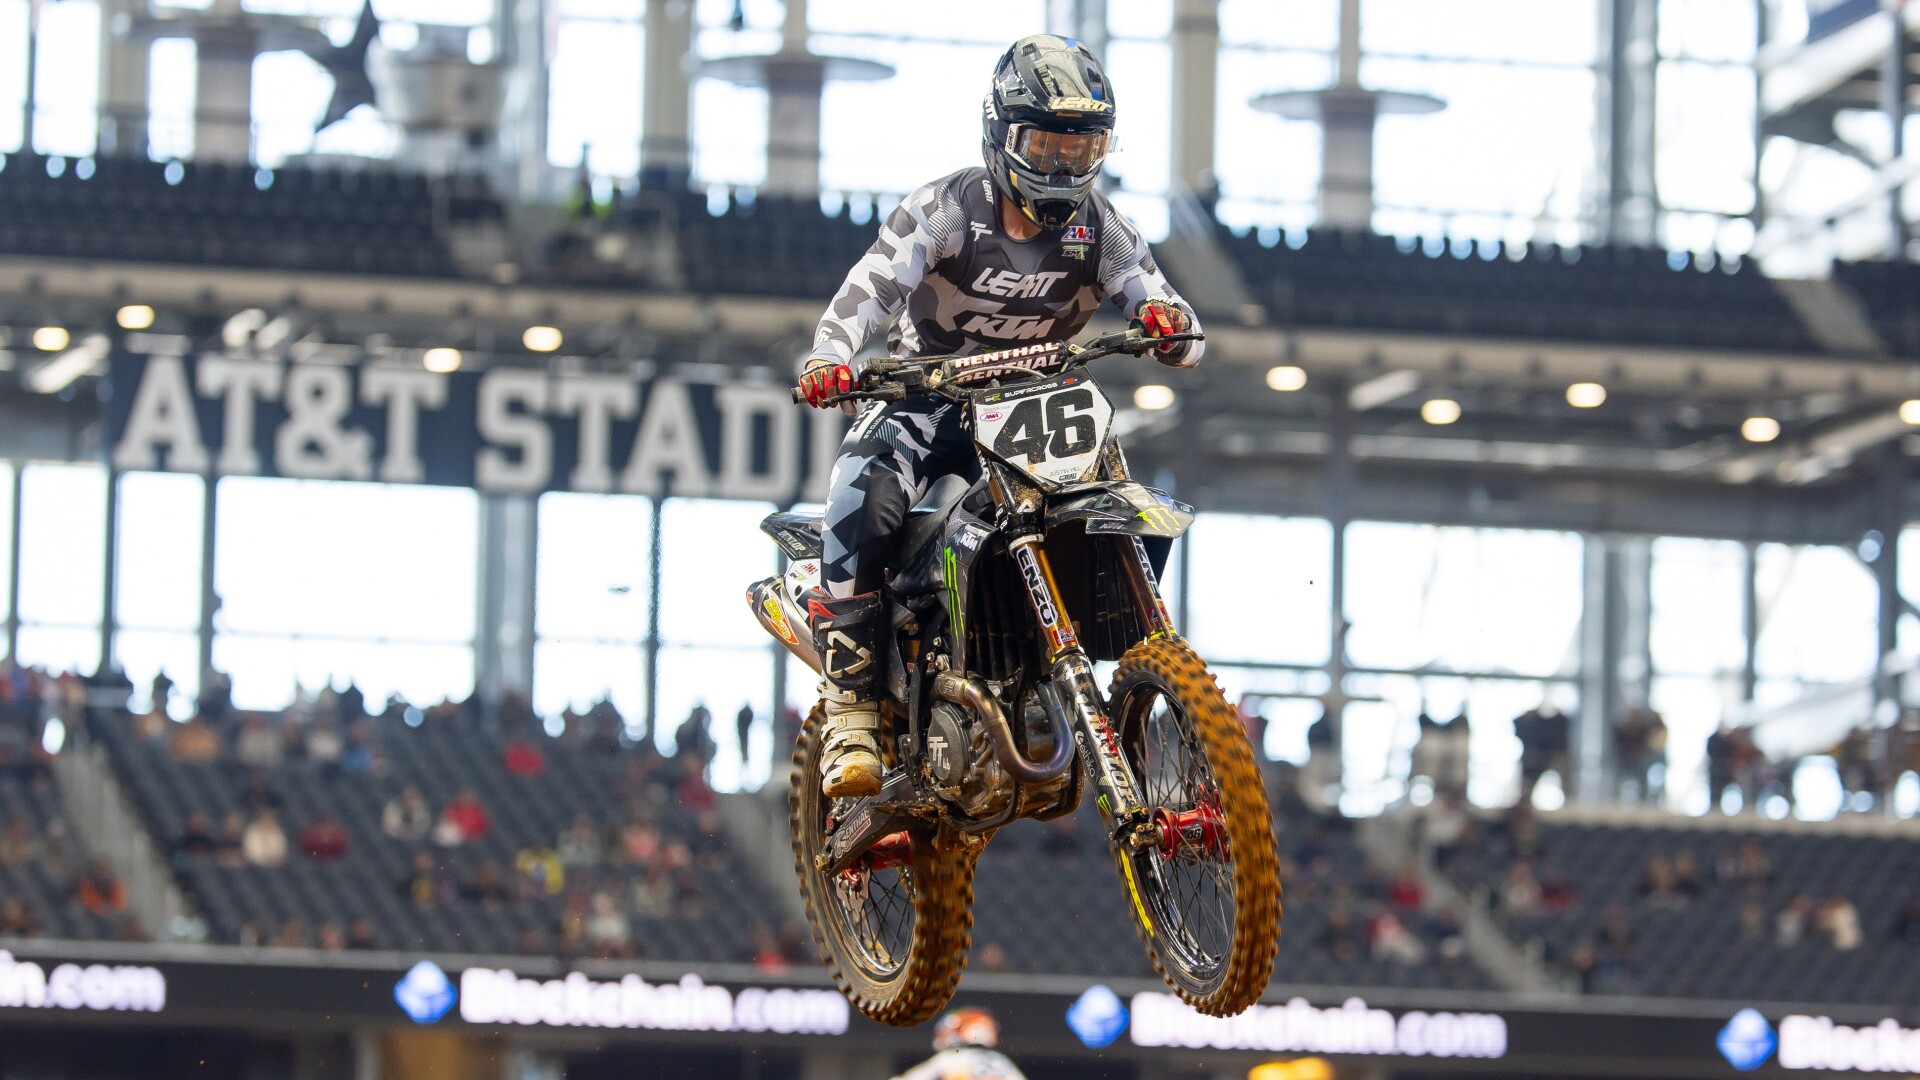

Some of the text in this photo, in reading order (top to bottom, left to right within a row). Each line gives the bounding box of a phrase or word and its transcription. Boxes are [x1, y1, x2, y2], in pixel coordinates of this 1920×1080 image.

[1049, 96, 1113, 112] LEATT
[1006, 127, 1015, 150] LEATT
[981, 179, 994, 205] LEATT
[971, 267, 1069, 299] LEATT
[961, 313, 1057, 340] KTM
[954, 341, 1061, 369] RENTHAL
[957, 353, 1062, 385] RENTHAL
[1004, 381, 1059, 399] SUPERCROSS
[112, 352, 447, 482] AT&T
[993, 388, 1098, 466] 46
[777, 529, 807, 552] DUNLOP
[960, 531, 979, 552] KTM
[1016, 544, 1058, 628] ENZO
[460, 967, 850, 1036] Blockchain.com
